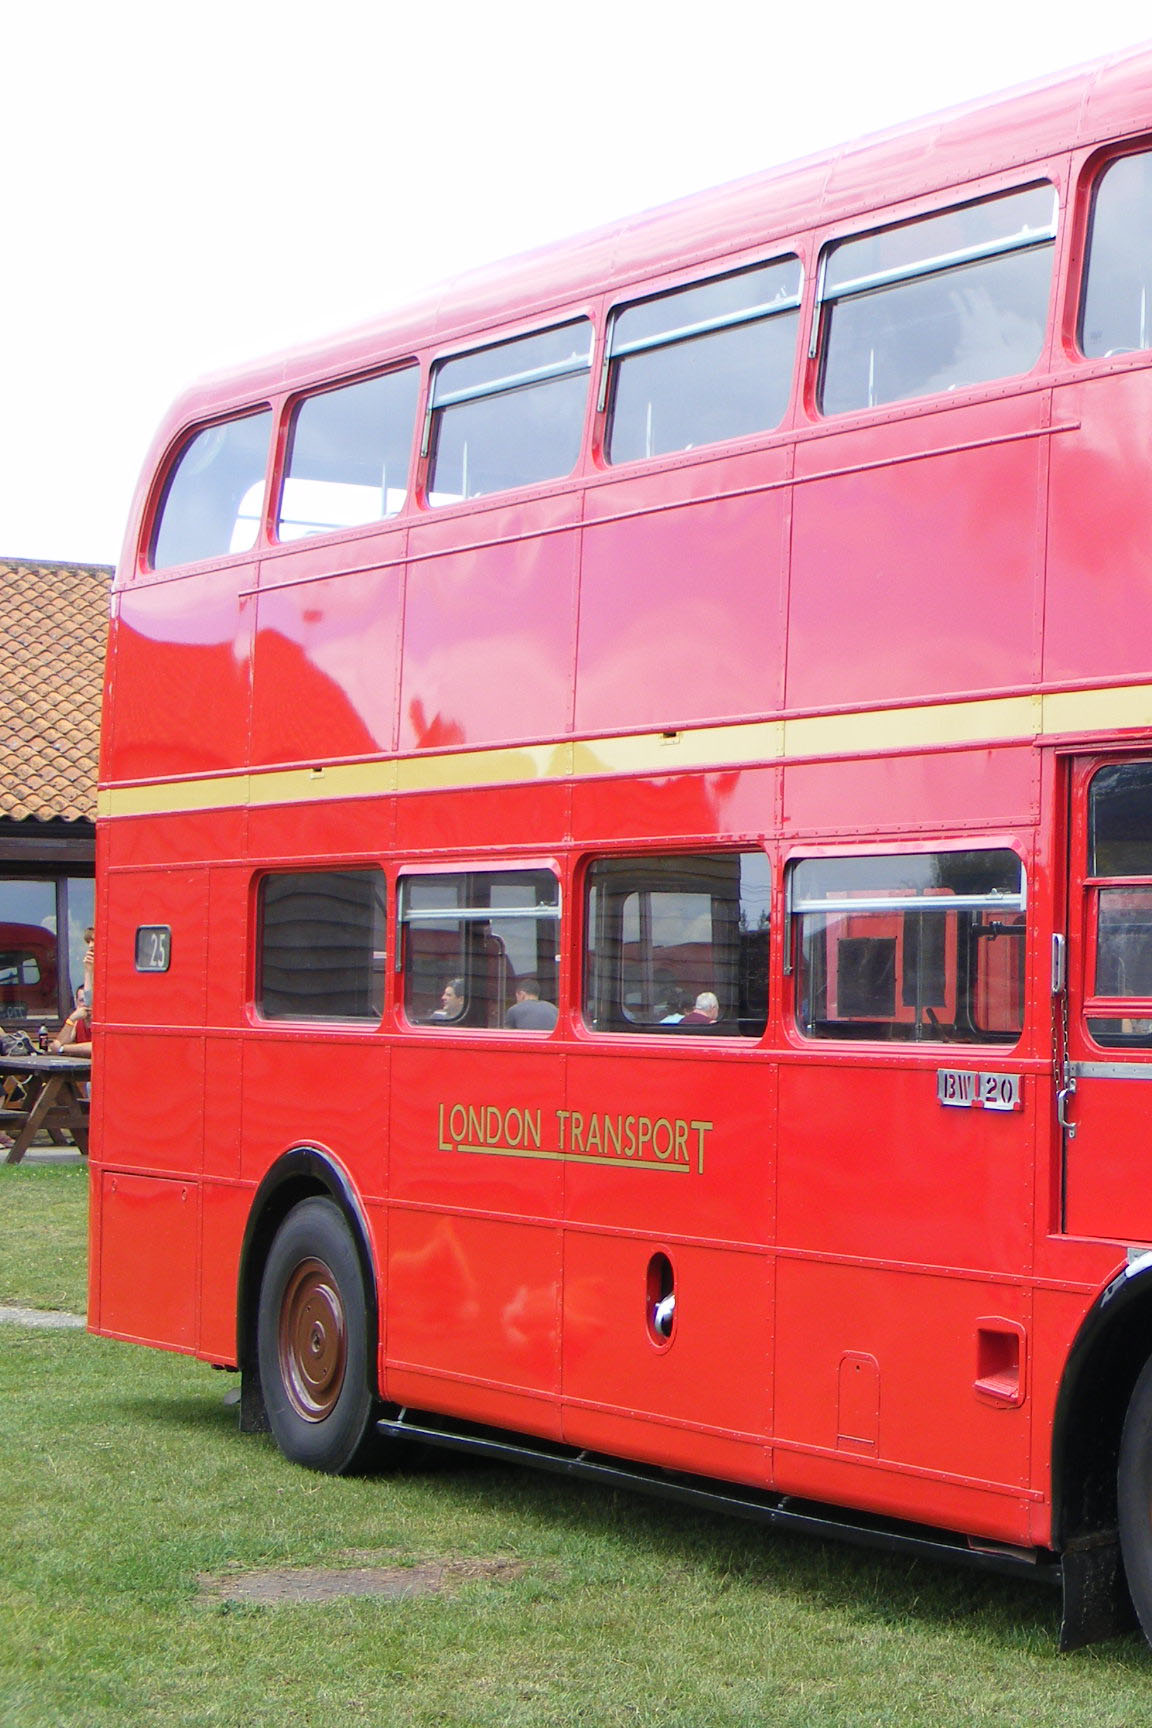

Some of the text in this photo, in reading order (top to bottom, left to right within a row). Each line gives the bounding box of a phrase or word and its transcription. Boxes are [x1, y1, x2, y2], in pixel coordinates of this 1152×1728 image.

[150, 933, 166, 967] 25
[985, 1077, 1013, 1103] 20
[439, 1103, 713, 1174] LONDON TRANSPORT
